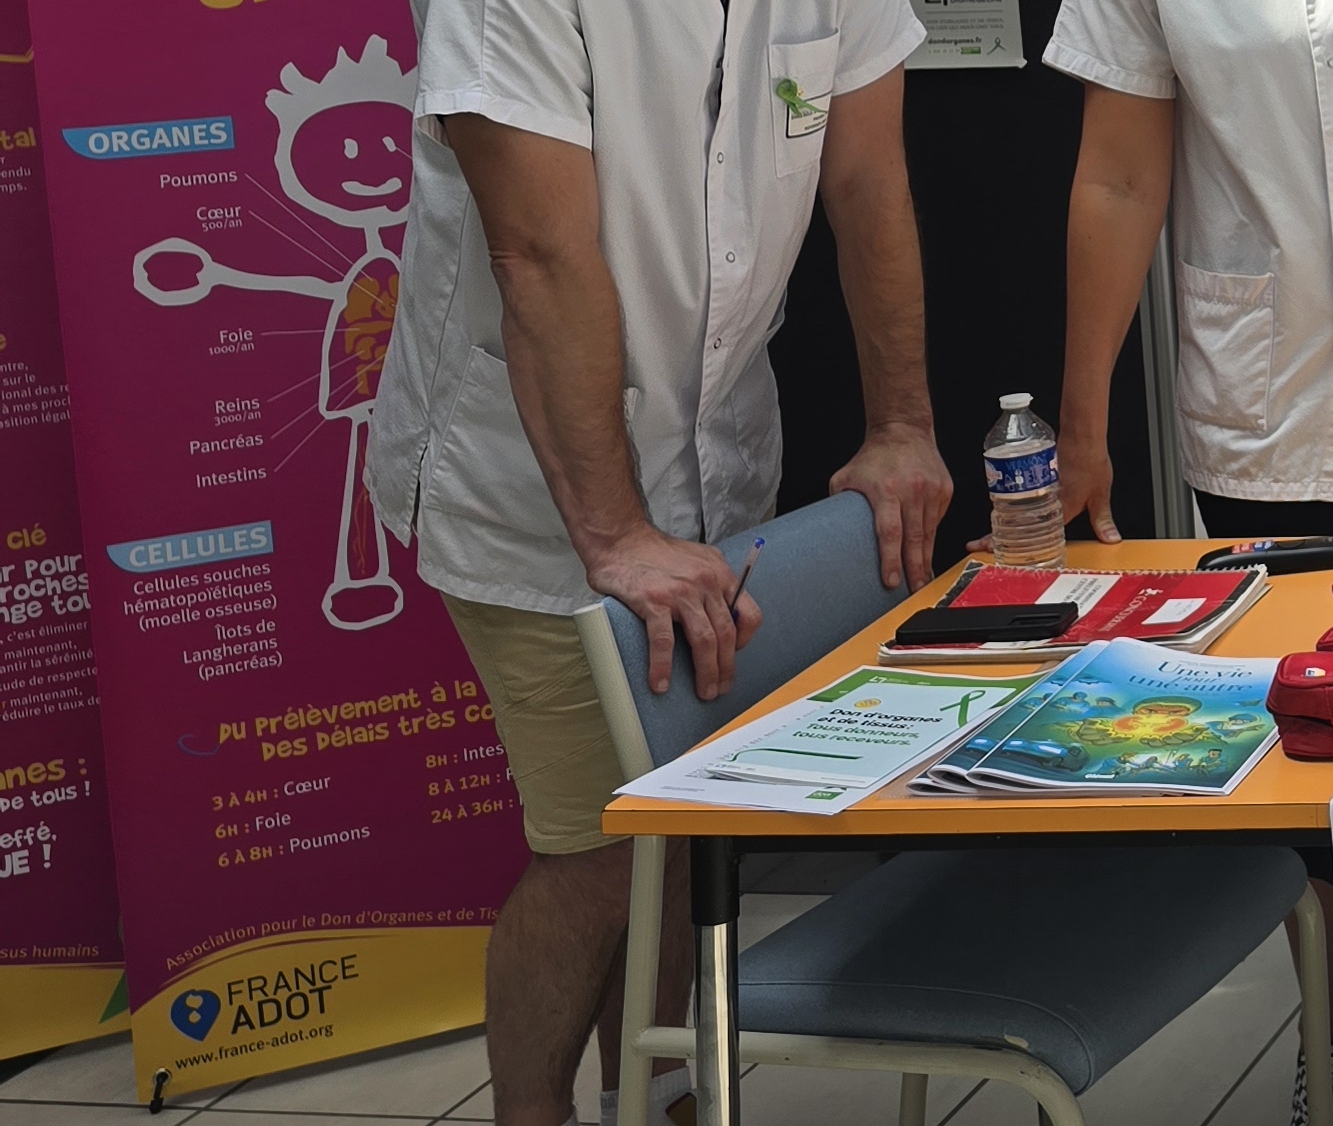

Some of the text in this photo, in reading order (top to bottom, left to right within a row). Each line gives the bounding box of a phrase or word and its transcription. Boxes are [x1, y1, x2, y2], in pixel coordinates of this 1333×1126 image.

[87, 122, 228, 154] ORGANES
[159, 170, 238, 189] Poumons
[196, 205, 242, 221] Cœur
[201, 218, 243, 233] 500/an
[219, 327, 253, 344] Foie
[208, 342, 255, 356] 1000/an
[214, 397, 260, 415] Reins
[214, 410, 262, 427] 3000/an
[189, 433, 264, 456] Pancréas
[195, 466, 268, 489] Intestins
[128, 526, 268, 568] CELLULES
[132, 561, 271, 596] Cellules souches
[122, 578, 273, 617] hématopoïétiques
[138, 592, 278, 633] (moelle osseuse)
[39, 620, 88, 639] éliminer
[214, 618, 276, 642] Îlots de
[182, 636, 278, 665] Langherans
[197, 650, 283, 682] (pancréas)
[1157, 660, 1253, 679] Une vie
[429, 680, 447, 703] à
[453, 678, 478, 700] la
[1128, 675, 1253, 692] une autre
[30, 784, 78, 808] tous
[211, 796, 223, 812] 3
[283, 775, 331, 798] Cœur
[32, 941, 100, 959] humains
[164, 907, 475, 971] Association pour le Don d'Organes et de
[226, 953, 360, 1007] FRANCE
[230, 983, 333, 1035] ADOT
[174, 1023, 335, 1071] www.france-adot.org
